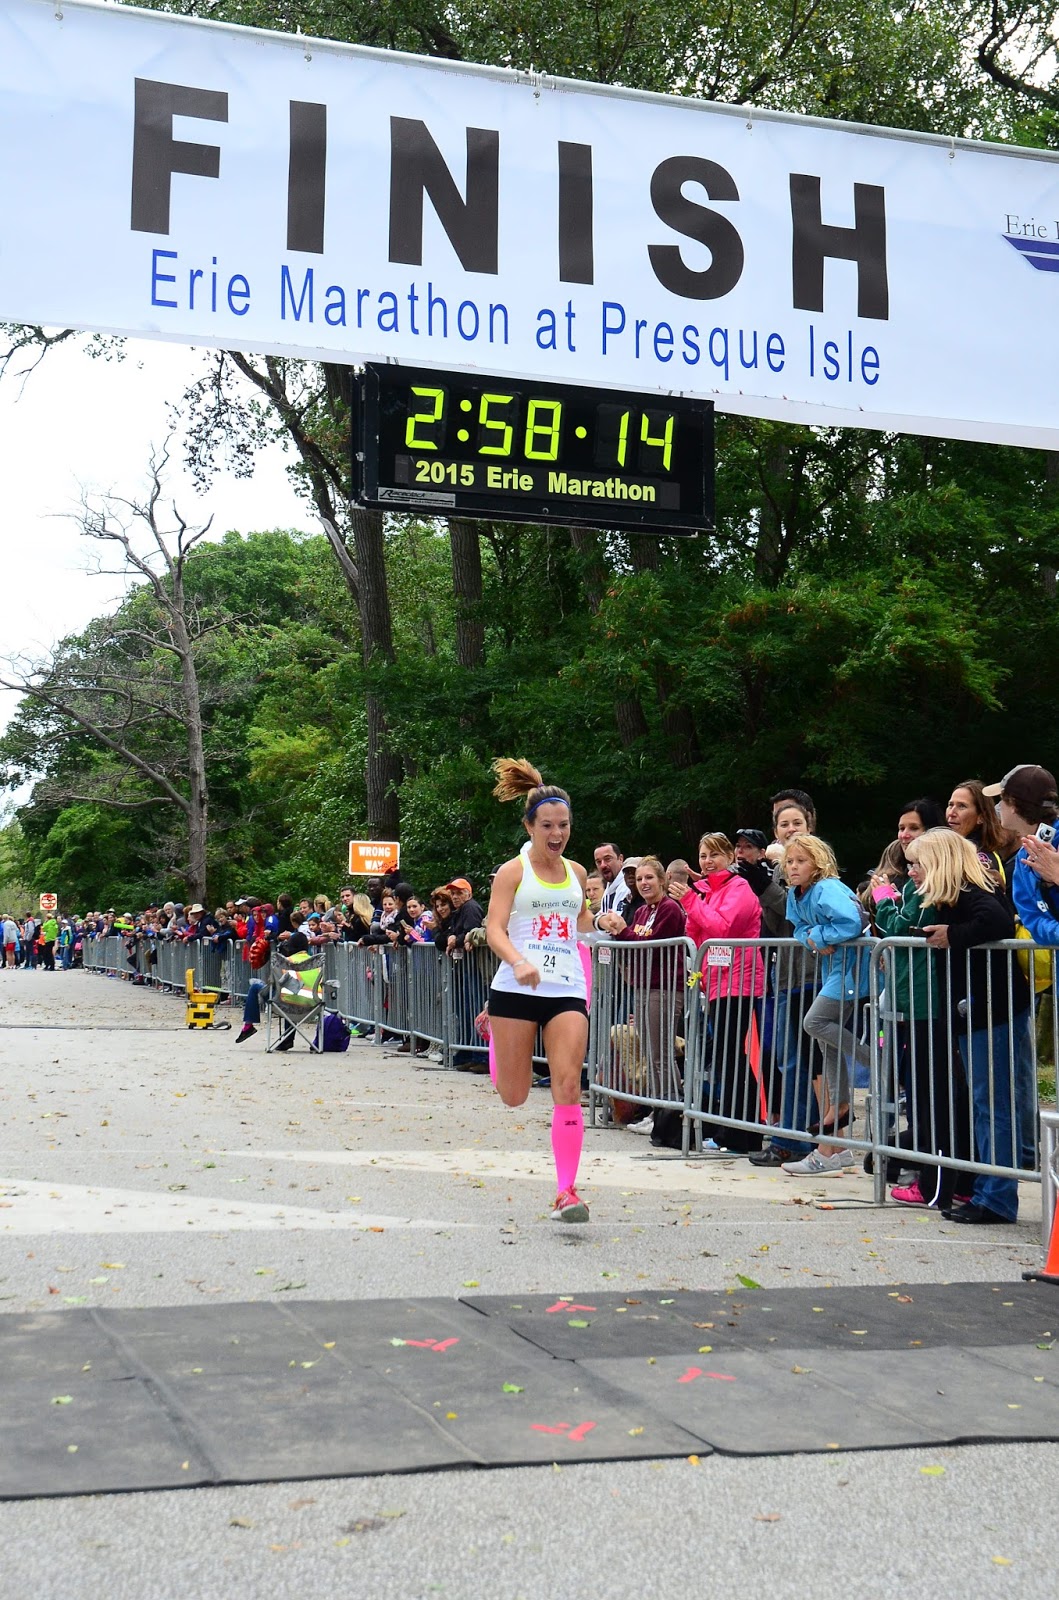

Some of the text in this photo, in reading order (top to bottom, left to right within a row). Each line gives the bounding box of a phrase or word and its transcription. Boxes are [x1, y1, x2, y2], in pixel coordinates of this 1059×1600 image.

[131, 77, 890, 321] FINISH
[1004, 213, 1048, 238] Erie
[151, 248, 881, 385] Erie Marathon at Presque Isle
[415, 460, 656, 502] 2015 Erie Marathon
[358, 846, 391, 858] WRONG
[365, 859, 384, 871] WAY
[528, 943, 541, 951] ERIE
[542, 944, 572, 955] MARATHON
[543, 954, 556, 968] 24
